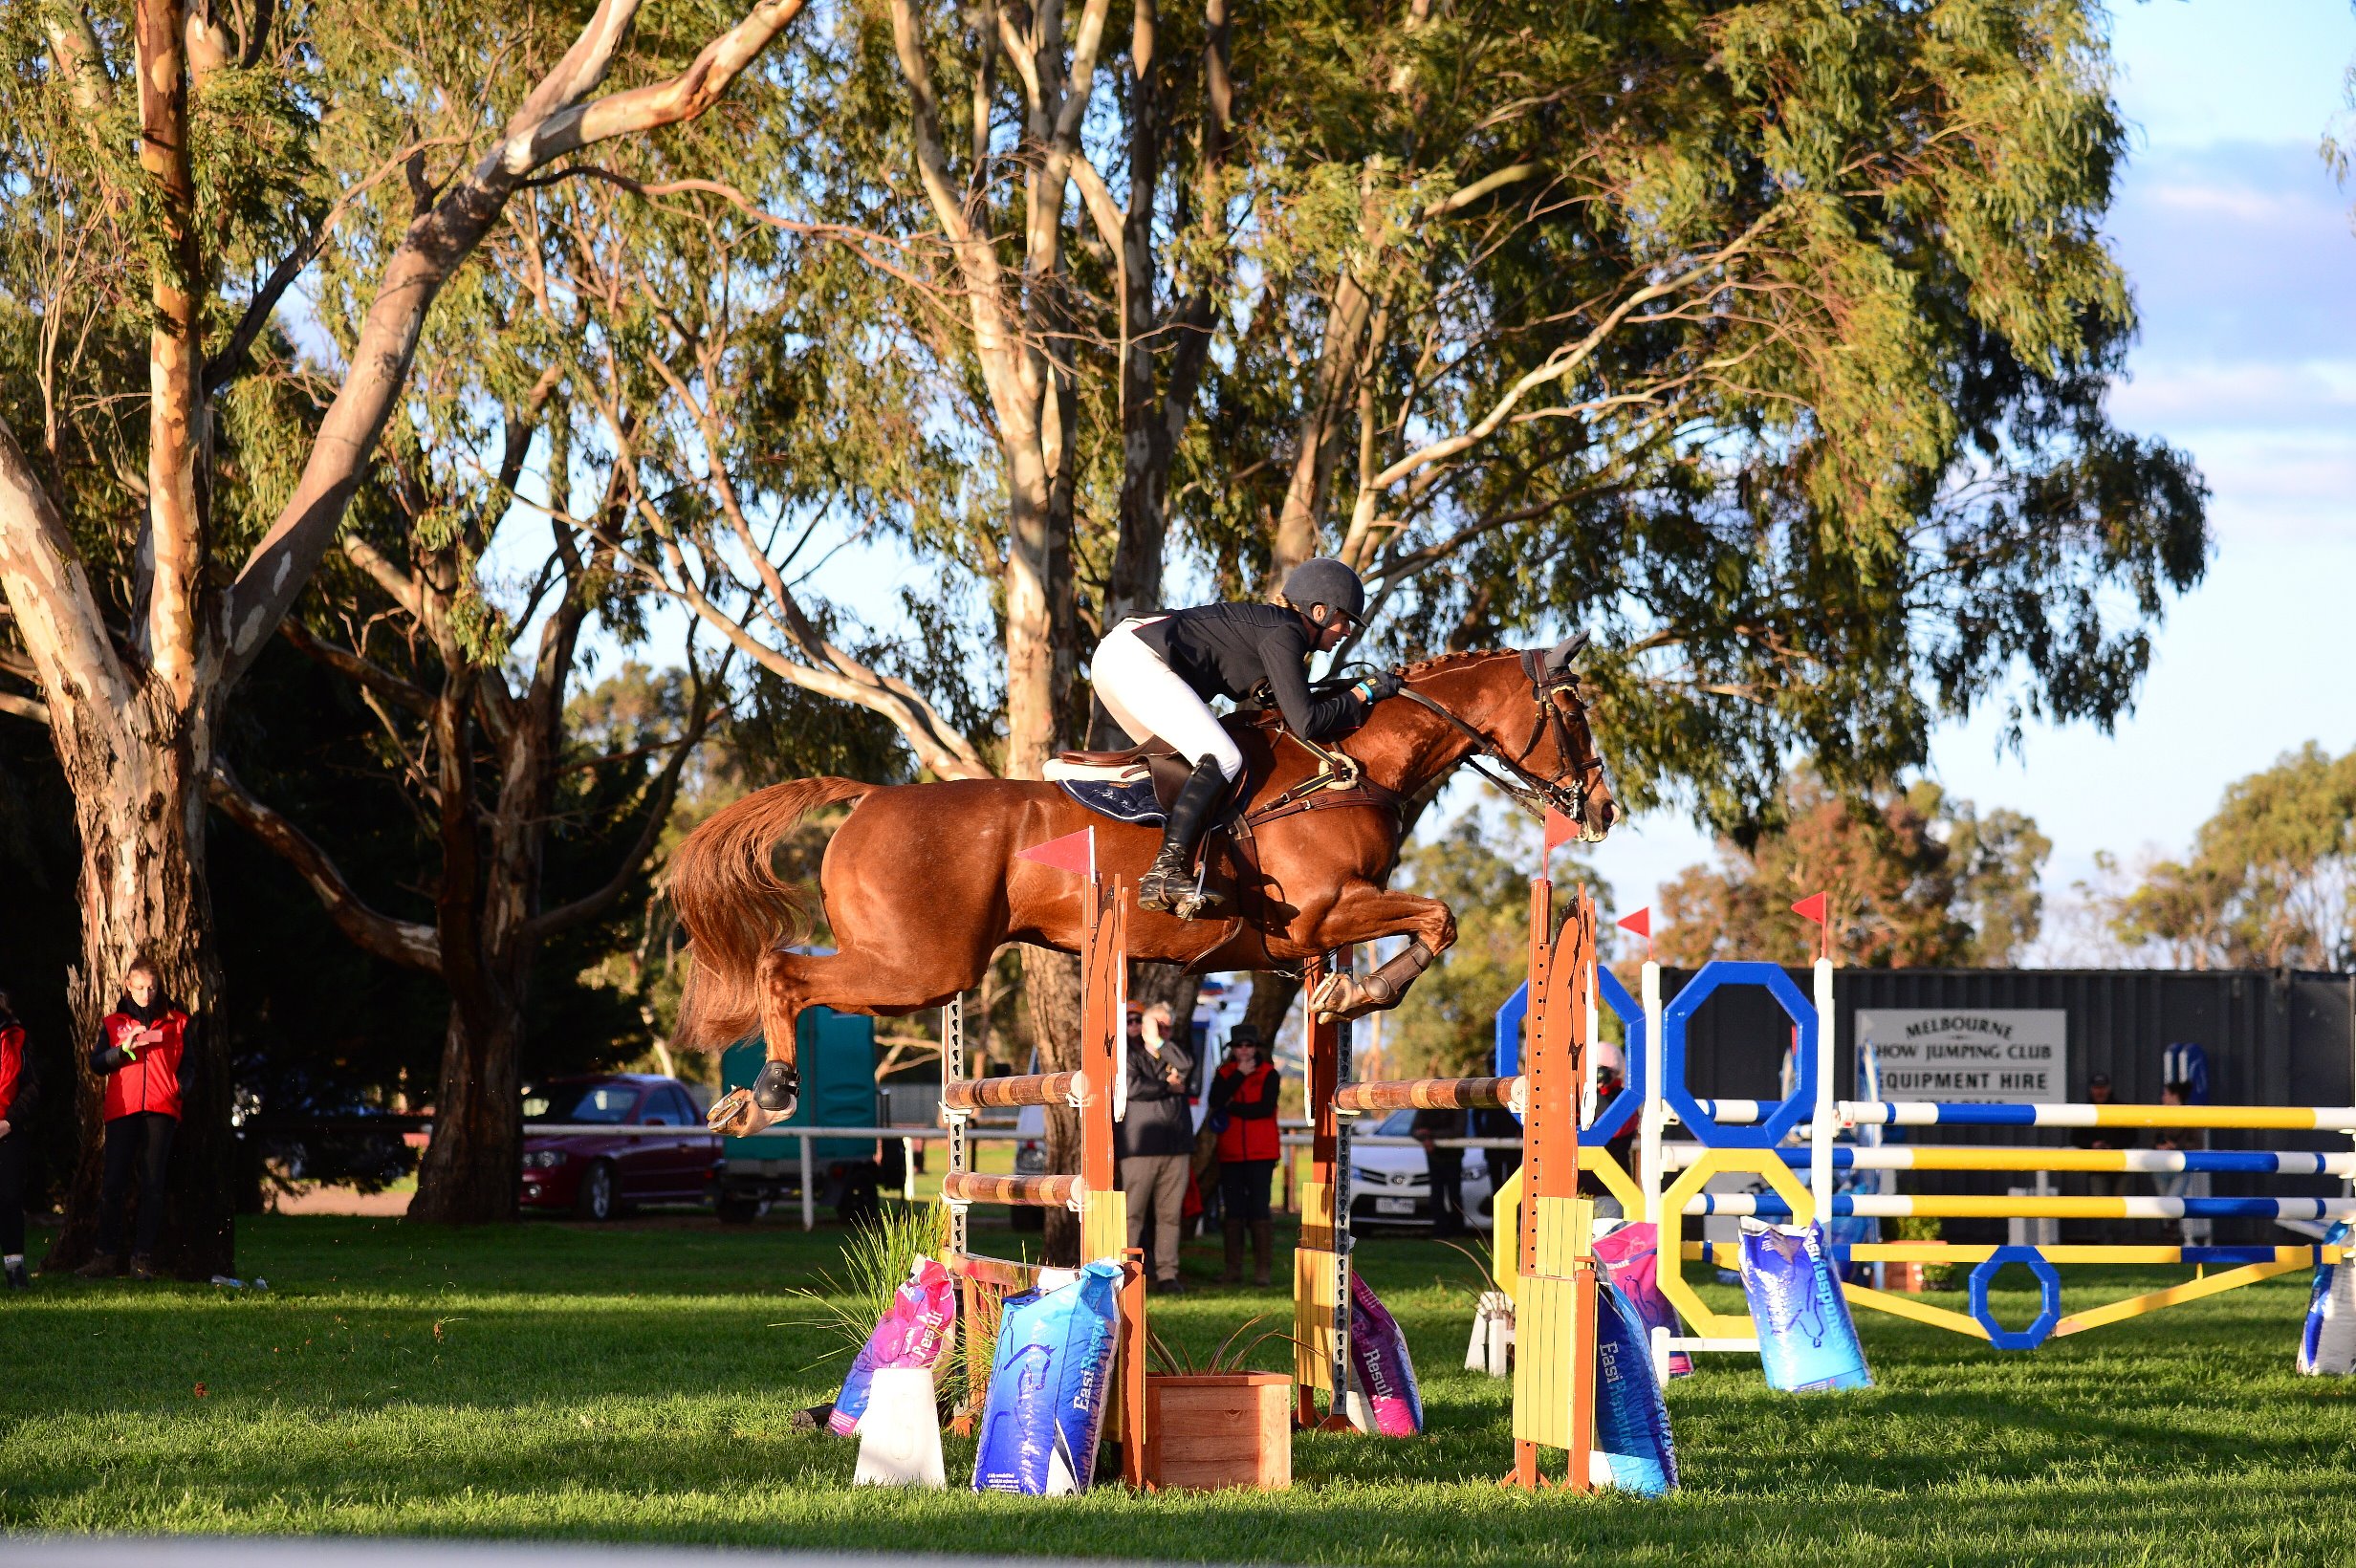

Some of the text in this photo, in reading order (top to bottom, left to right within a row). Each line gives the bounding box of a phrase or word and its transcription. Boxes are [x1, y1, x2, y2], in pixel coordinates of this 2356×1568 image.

[1906, 1016, 2014, 1040] MELBOURNE
[1876, 1044, 2052, 1060] HOW JUMPING CLUB
[1880, 1072, 2047, 1090] QUIPMENT HIRE
